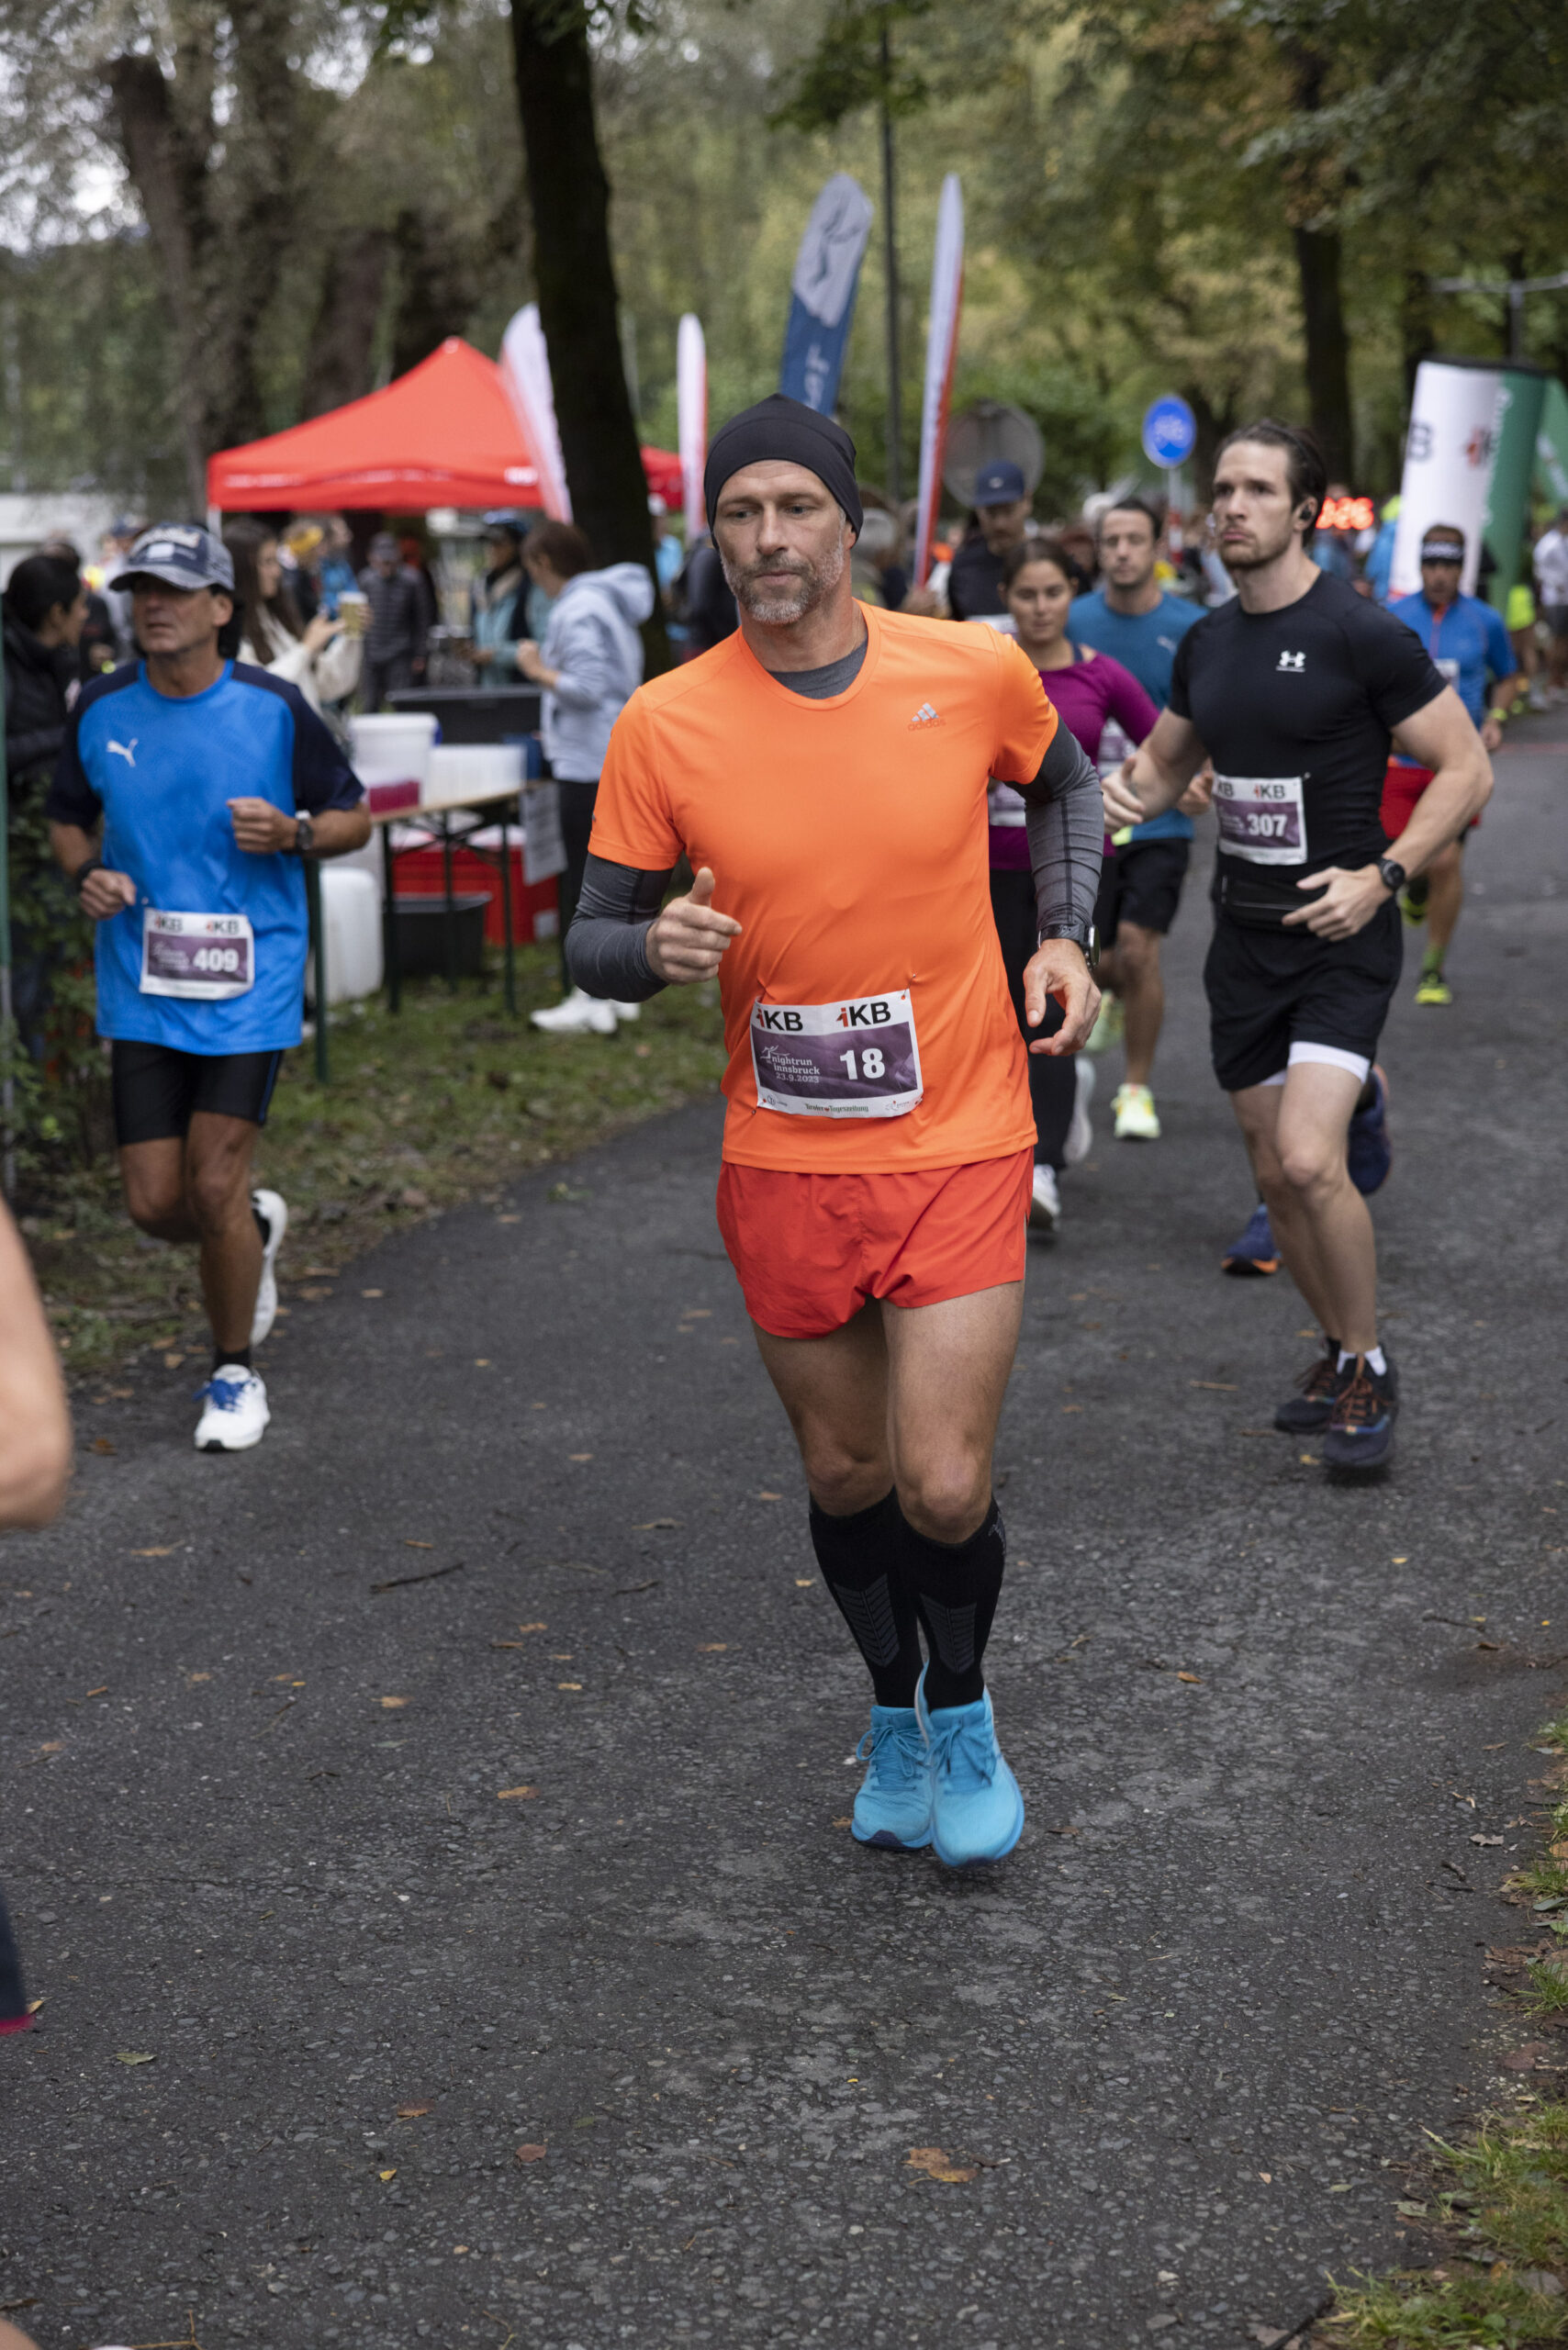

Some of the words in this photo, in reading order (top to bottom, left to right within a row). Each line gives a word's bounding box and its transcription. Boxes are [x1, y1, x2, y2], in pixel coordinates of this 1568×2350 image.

[907, 718, 947, 732] adidas
[1247, 813, 1288, 837] 307
[193, 947, 240, 972] 409
[771, 1055, 812, 1066] nightrun
[839, 1047, 886, 1080] 18
[776, 1072, 820, 1083] 23.9.2023
